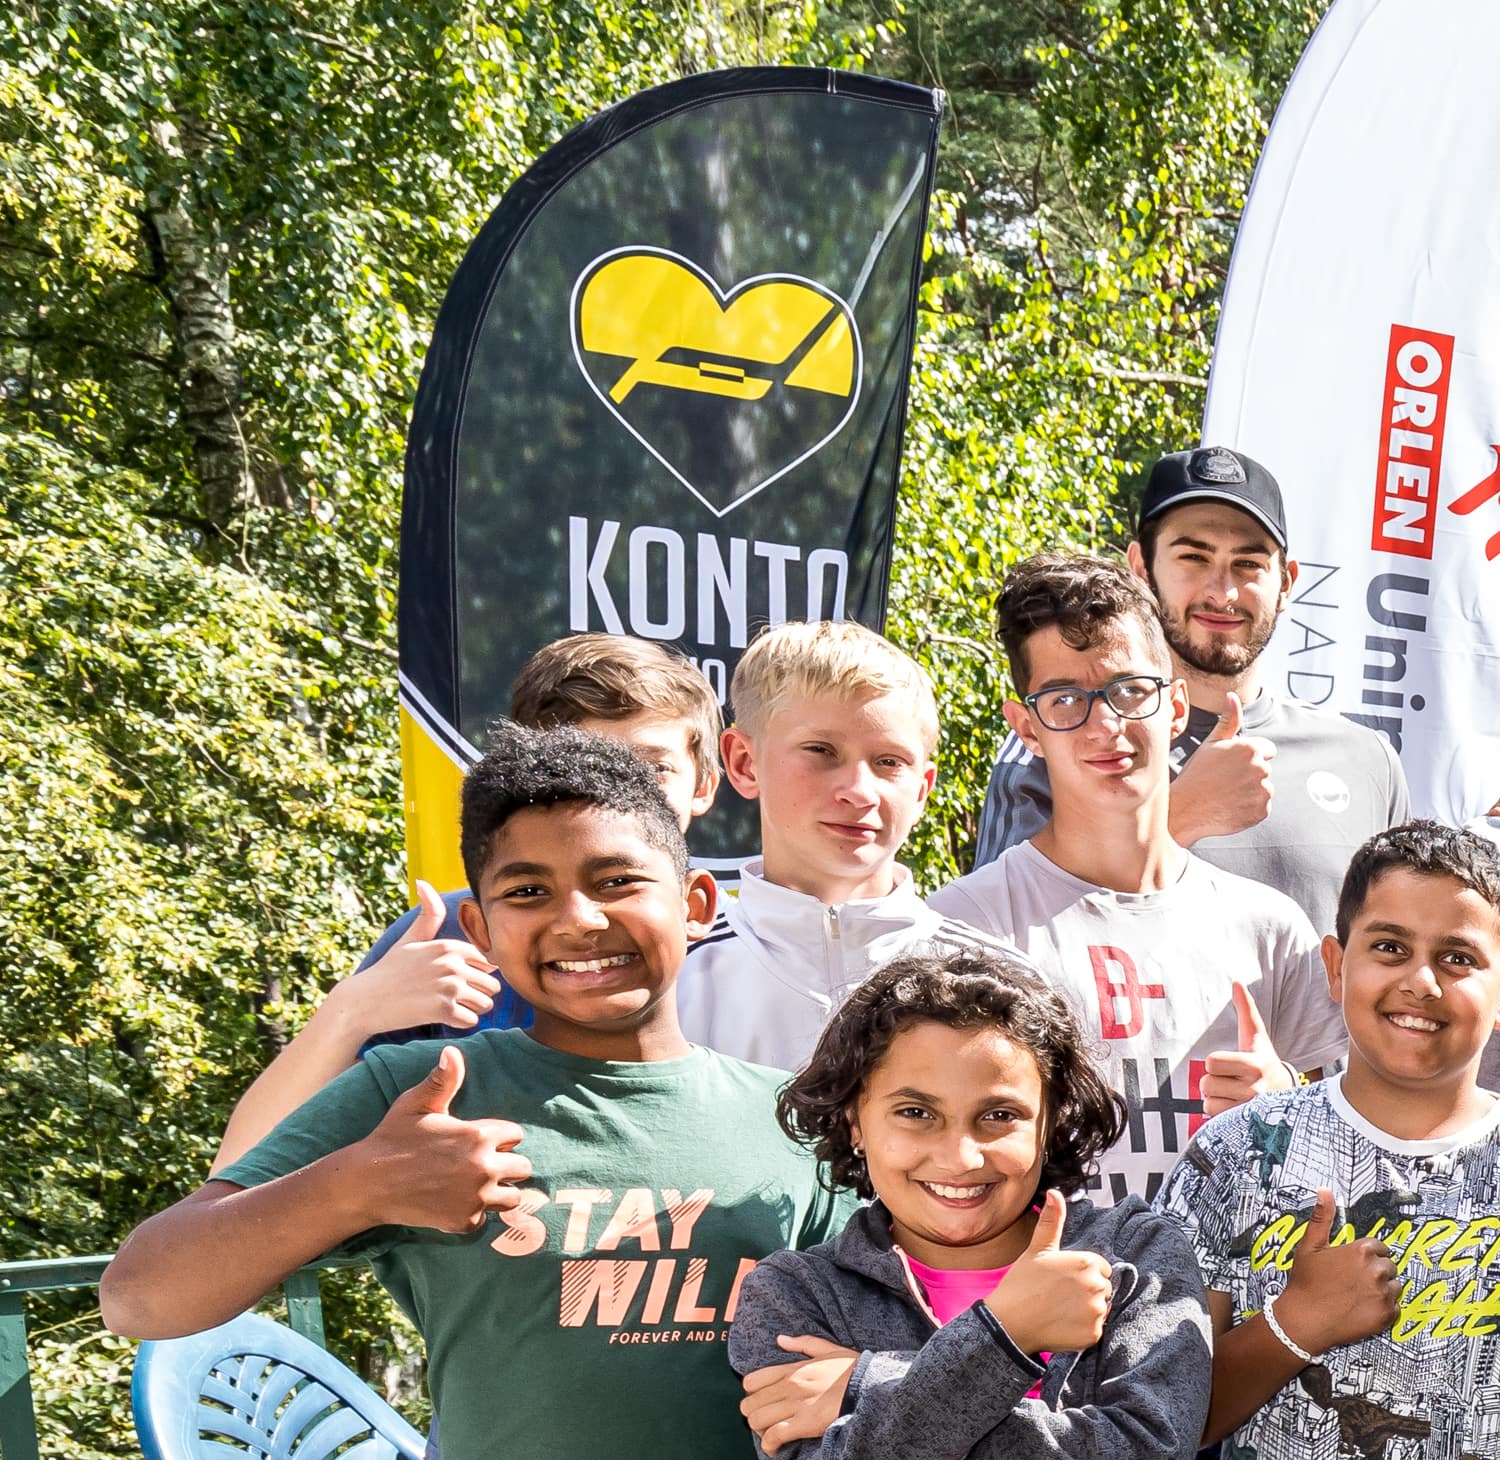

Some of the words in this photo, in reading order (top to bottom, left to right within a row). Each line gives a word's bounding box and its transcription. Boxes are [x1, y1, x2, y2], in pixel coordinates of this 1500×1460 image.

[1382, 340, 1443, 544] ORLEN
[569, 515, 849, 648] KONTO
[490, 1187, 715, 1257] STAY
[609, 1330, 681, 1345] FOREVER
[686, 1330, 715, 1342] AND
